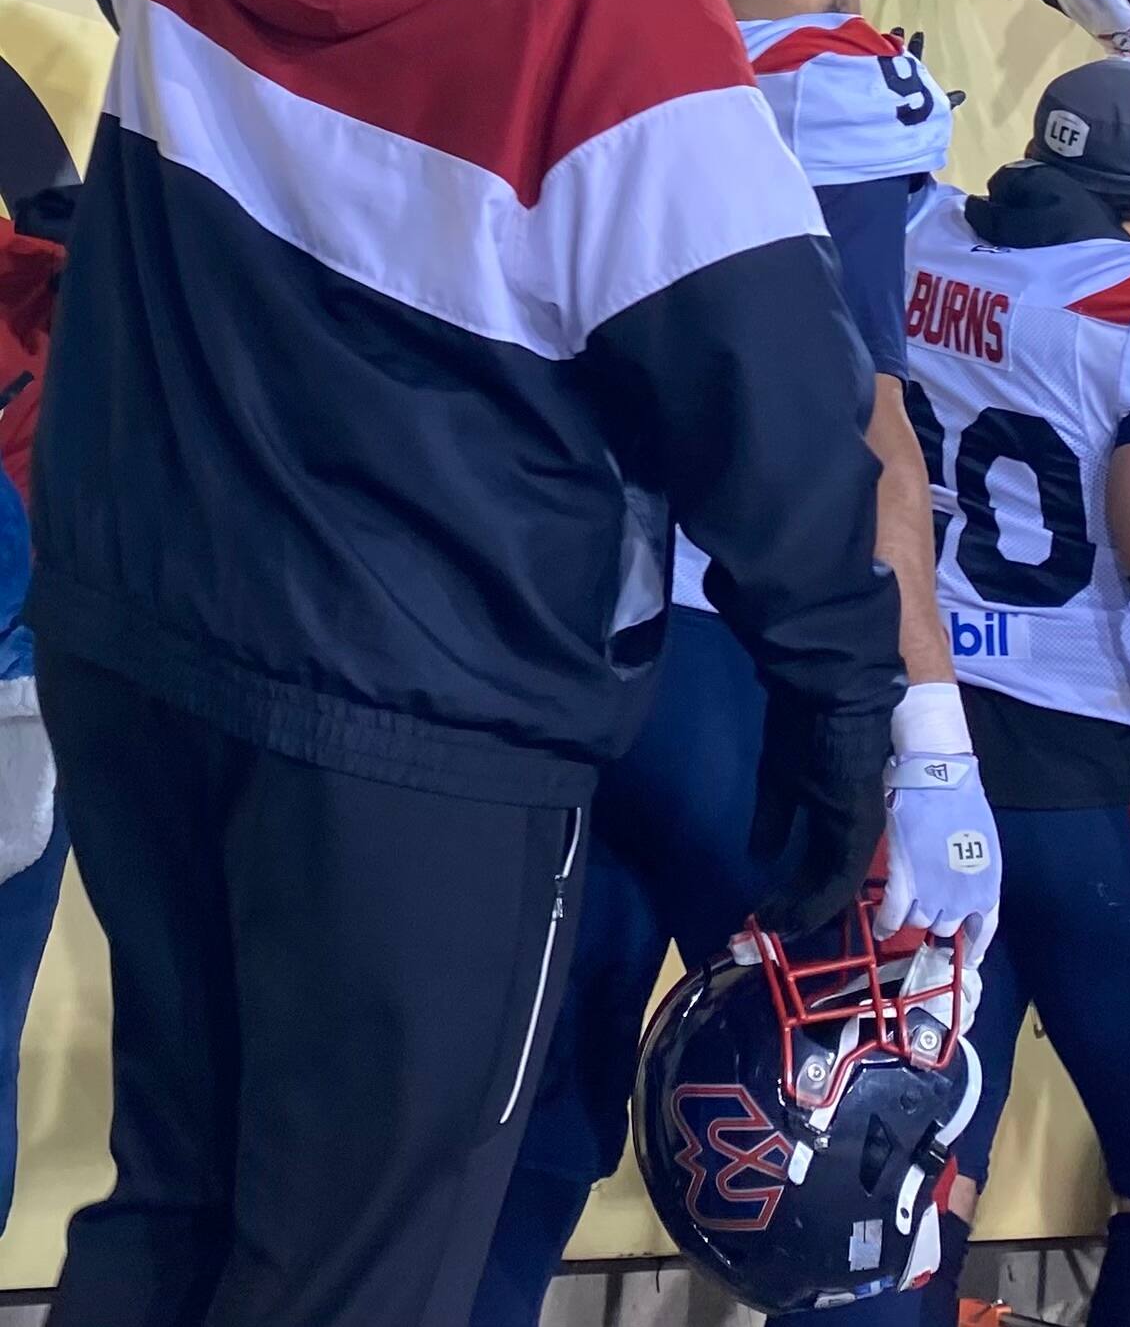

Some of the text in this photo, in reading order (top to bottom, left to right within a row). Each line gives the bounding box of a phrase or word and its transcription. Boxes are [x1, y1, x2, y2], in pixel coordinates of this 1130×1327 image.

[878, 56, 935, 127] 9
[1050, 120, 1080, 147] LCF
[906, 271, 1010, 364] BURNS
[943, 611, 1009, 657] bil
[952, 841, 983, 860] CFL
